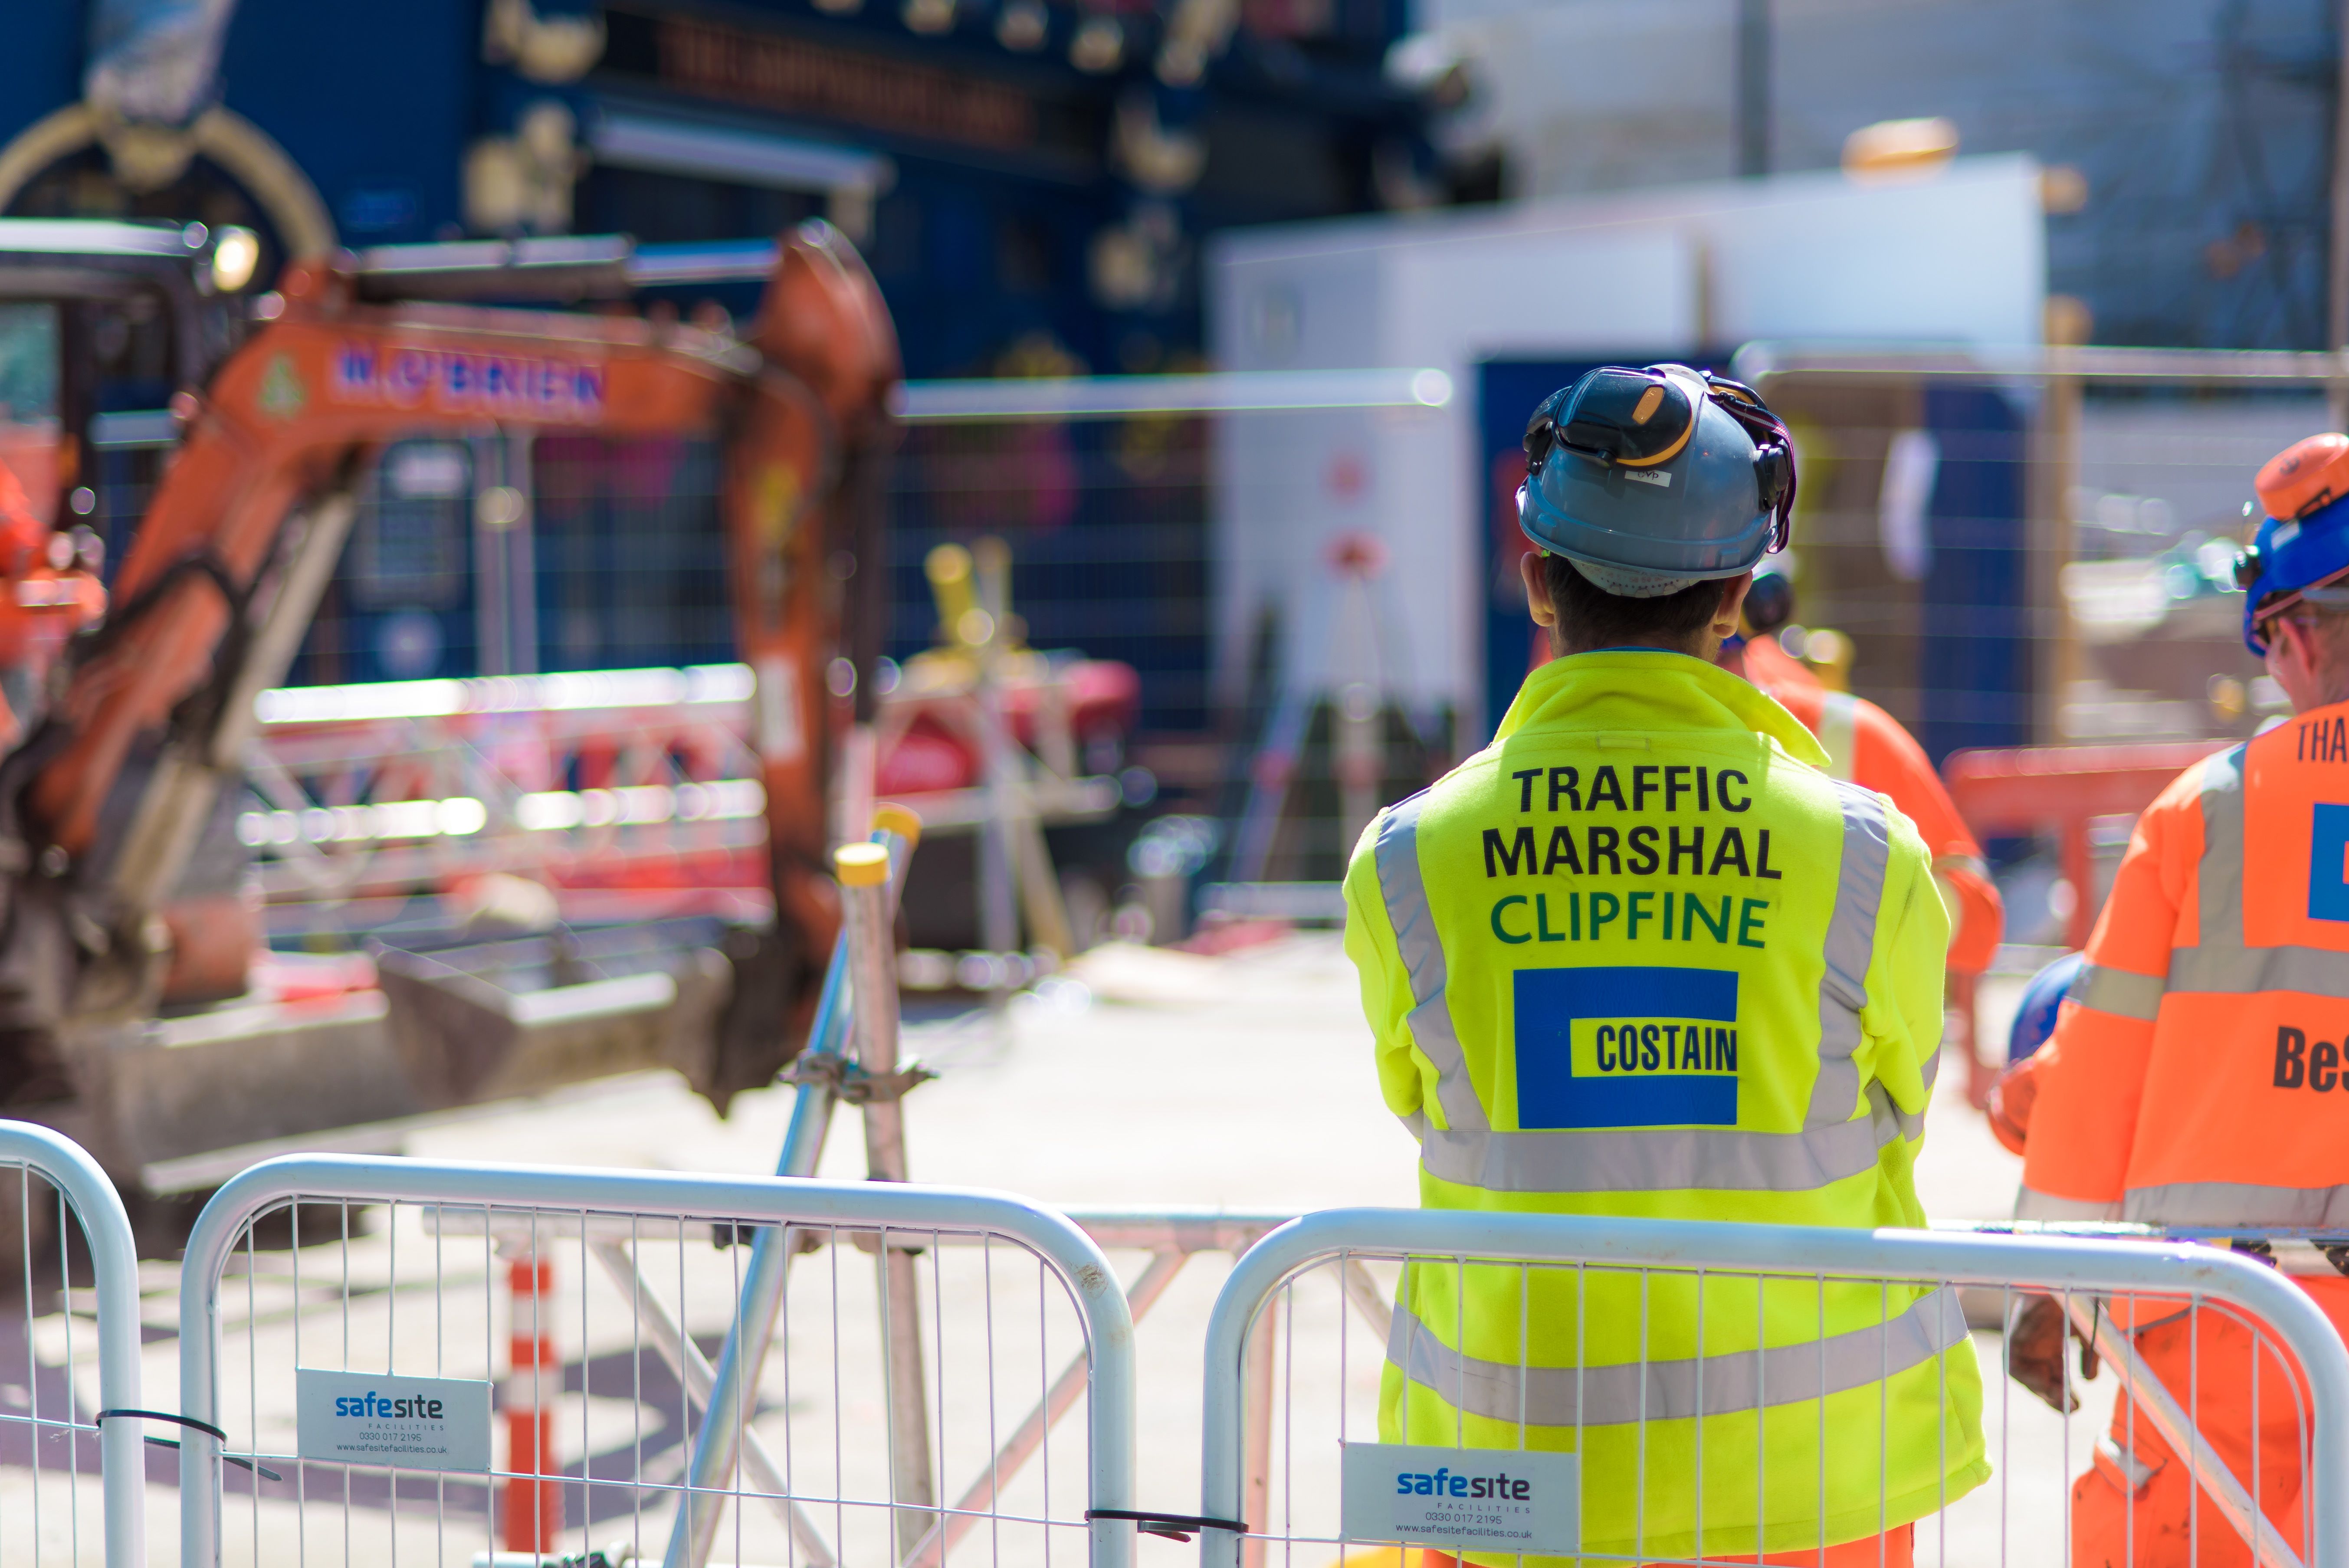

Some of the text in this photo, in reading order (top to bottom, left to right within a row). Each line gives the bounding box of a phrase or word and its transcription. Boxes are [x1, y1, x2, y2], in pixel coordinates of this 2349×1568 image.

[1512, 765, 1752, 813] TRAFFIC
[1482, 826, 1782, 880] MARSHAL
[1491, 892, 1770, 948] CLIPFINE
[1597, 1024, 1737, 1072] COSTAIN
[2273, 1025, 2349, 1092] Be
[336, 1391, 443, 1419] safesite
[337, 1443, 447, 1453] www.safesitefacilities.co.uk
[1398, 1468, 1530, 1501] safesite
[1426, 1512, 1502, 1525] 0330 017 2195
[1437, 1502, 1530, 1514] FACILITIES
[1396, 1524, 1532, 1539] www.safesitefacilities.co.uk
